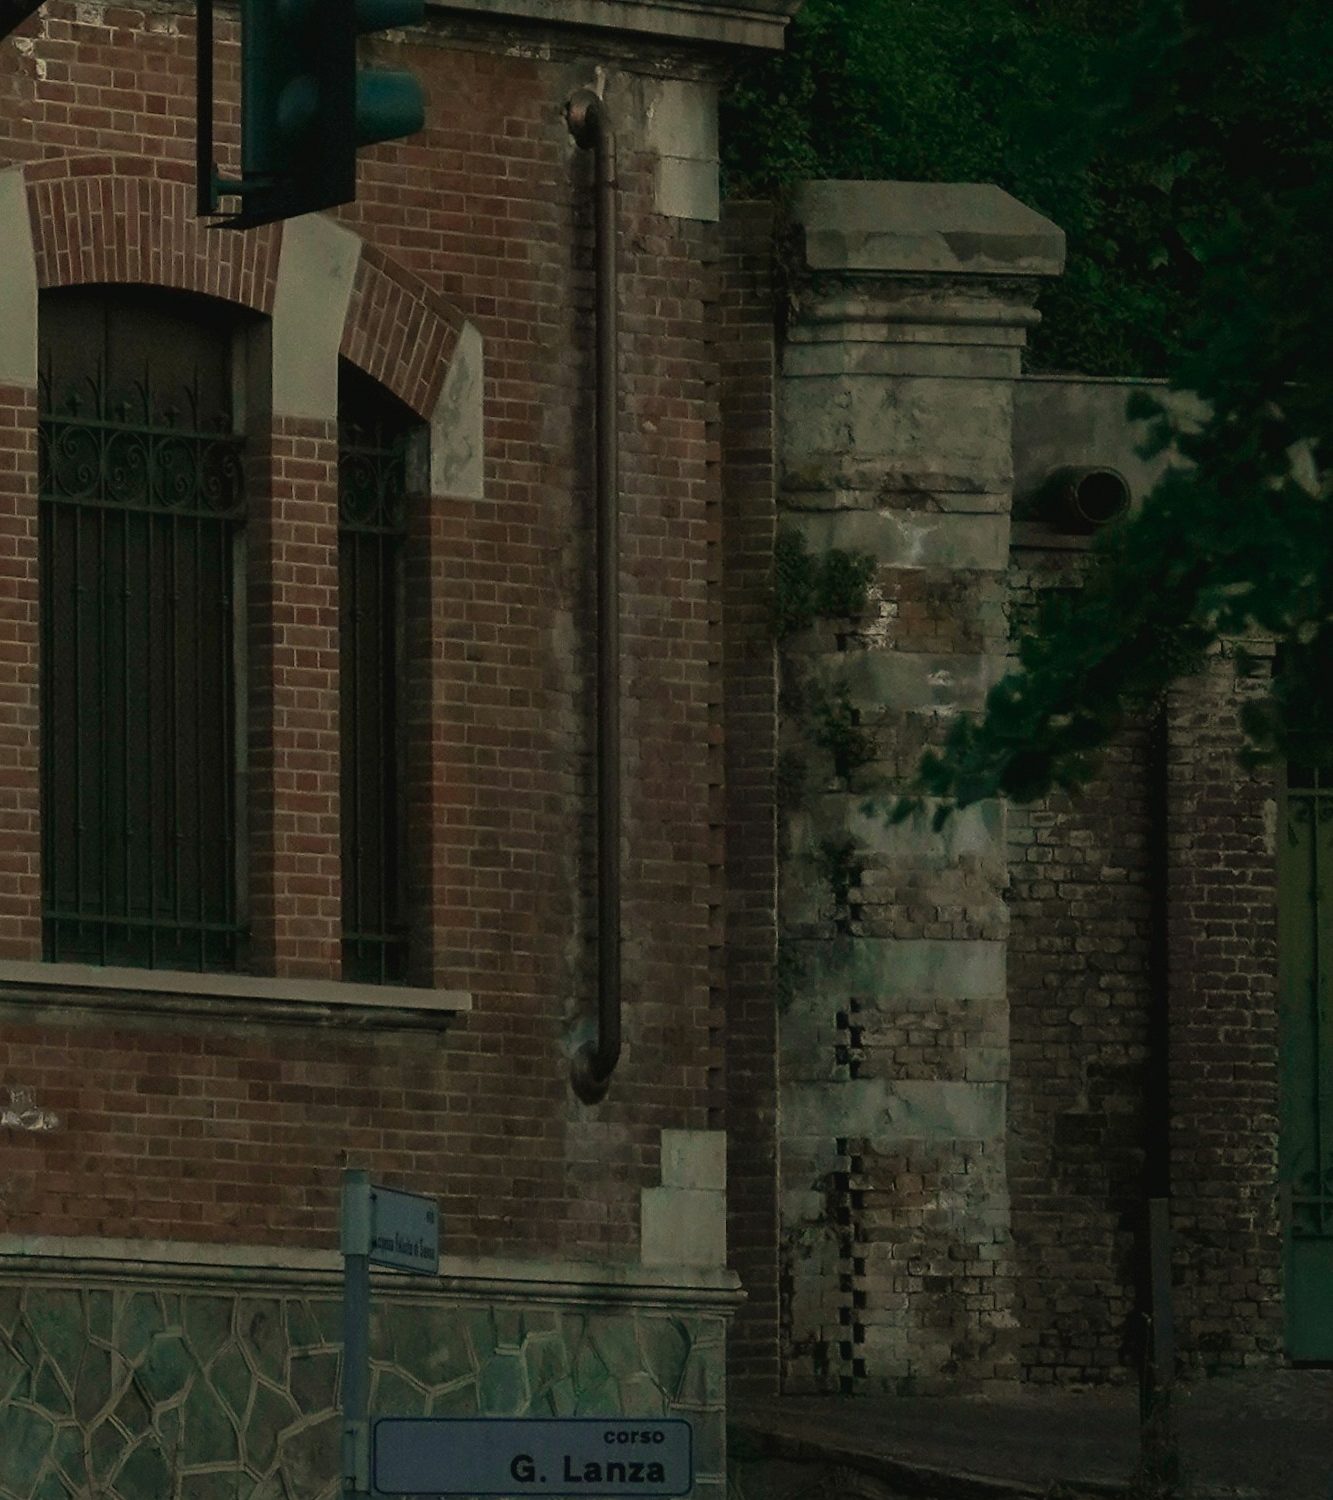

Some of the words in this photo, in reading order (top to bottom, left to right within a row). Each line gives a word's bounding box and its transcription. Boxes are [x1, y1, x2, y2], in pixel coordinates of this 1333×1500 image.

[603, 1430, 665, 1445] corso
[510, 1454, 547, 1483] G.
[563, 1454, 665, 1483] Lanza
